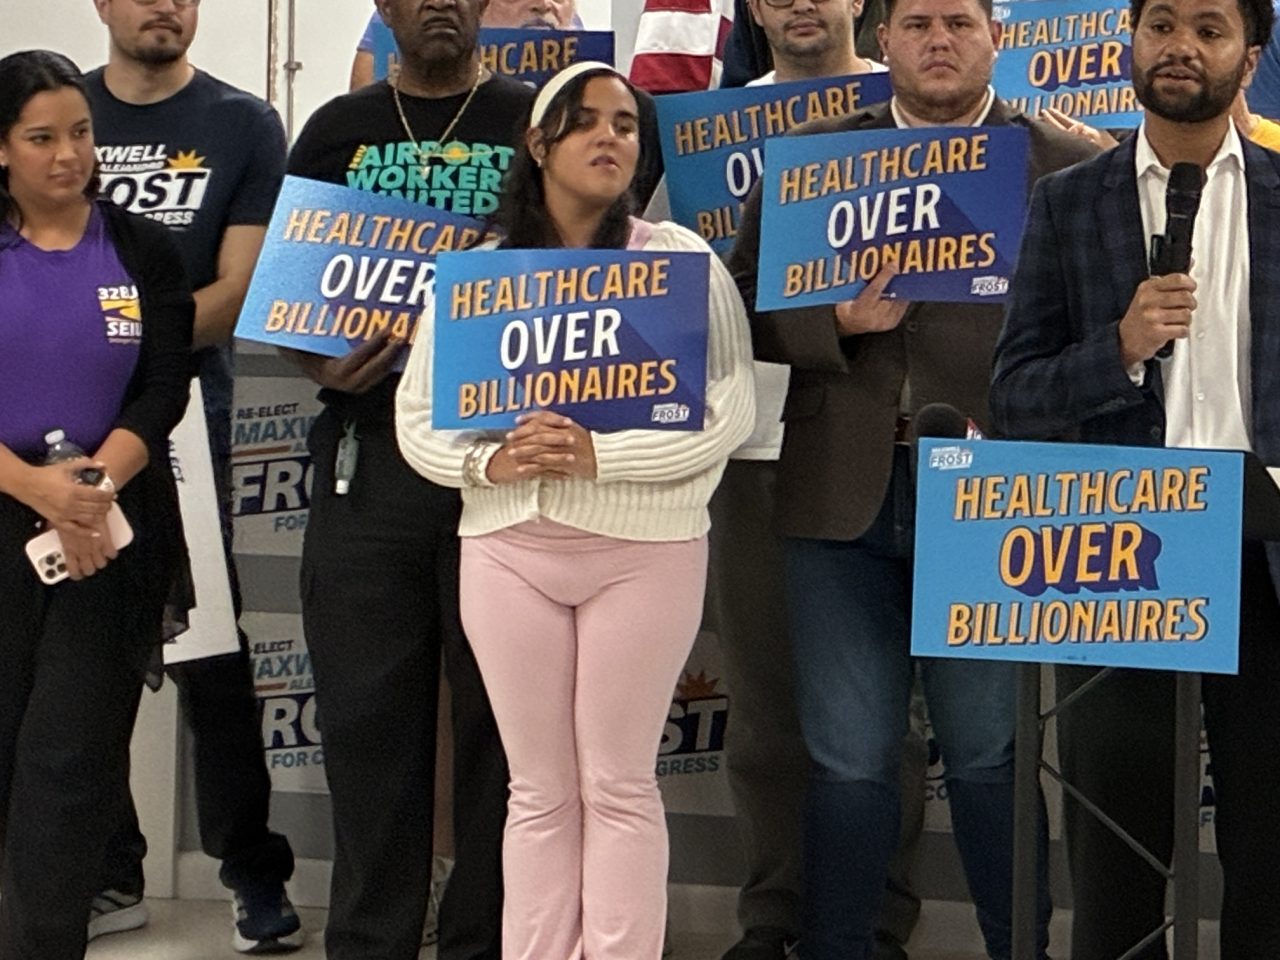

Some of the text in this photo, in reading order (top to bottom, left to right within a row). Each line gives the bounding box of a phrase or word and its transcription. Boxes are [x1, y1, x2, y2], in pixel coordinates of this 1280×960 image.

[1000, 8, 1134, 49] HEALTHCA
[1028, 40, 1124, 87] OVER
[675, 82, 862, 156] HEALTHCARE
[346, 164, 503, 191] WORKER
[360, 140, 516, 171] AIRPORT
[779, 134, 989, 205] HEALTHCARE
[104, 172, 208, 210] OST
[827, 183, 942, 249] OVER
[320, 253, 437, 306] OVER
[450, 258, 671, 321] HEALTHCARE
[783, 233, 997, 299] BILLIONAIRES
[500, 307, 622, 371] OVER
[458, 358, 678, 421] BILLIONAIRES
[953, 466, 1210, 521] HEALTHCARE
[999, 520, 1144, 588] OVER
[946, 597, 1209, 646] BILLIONAIRES
